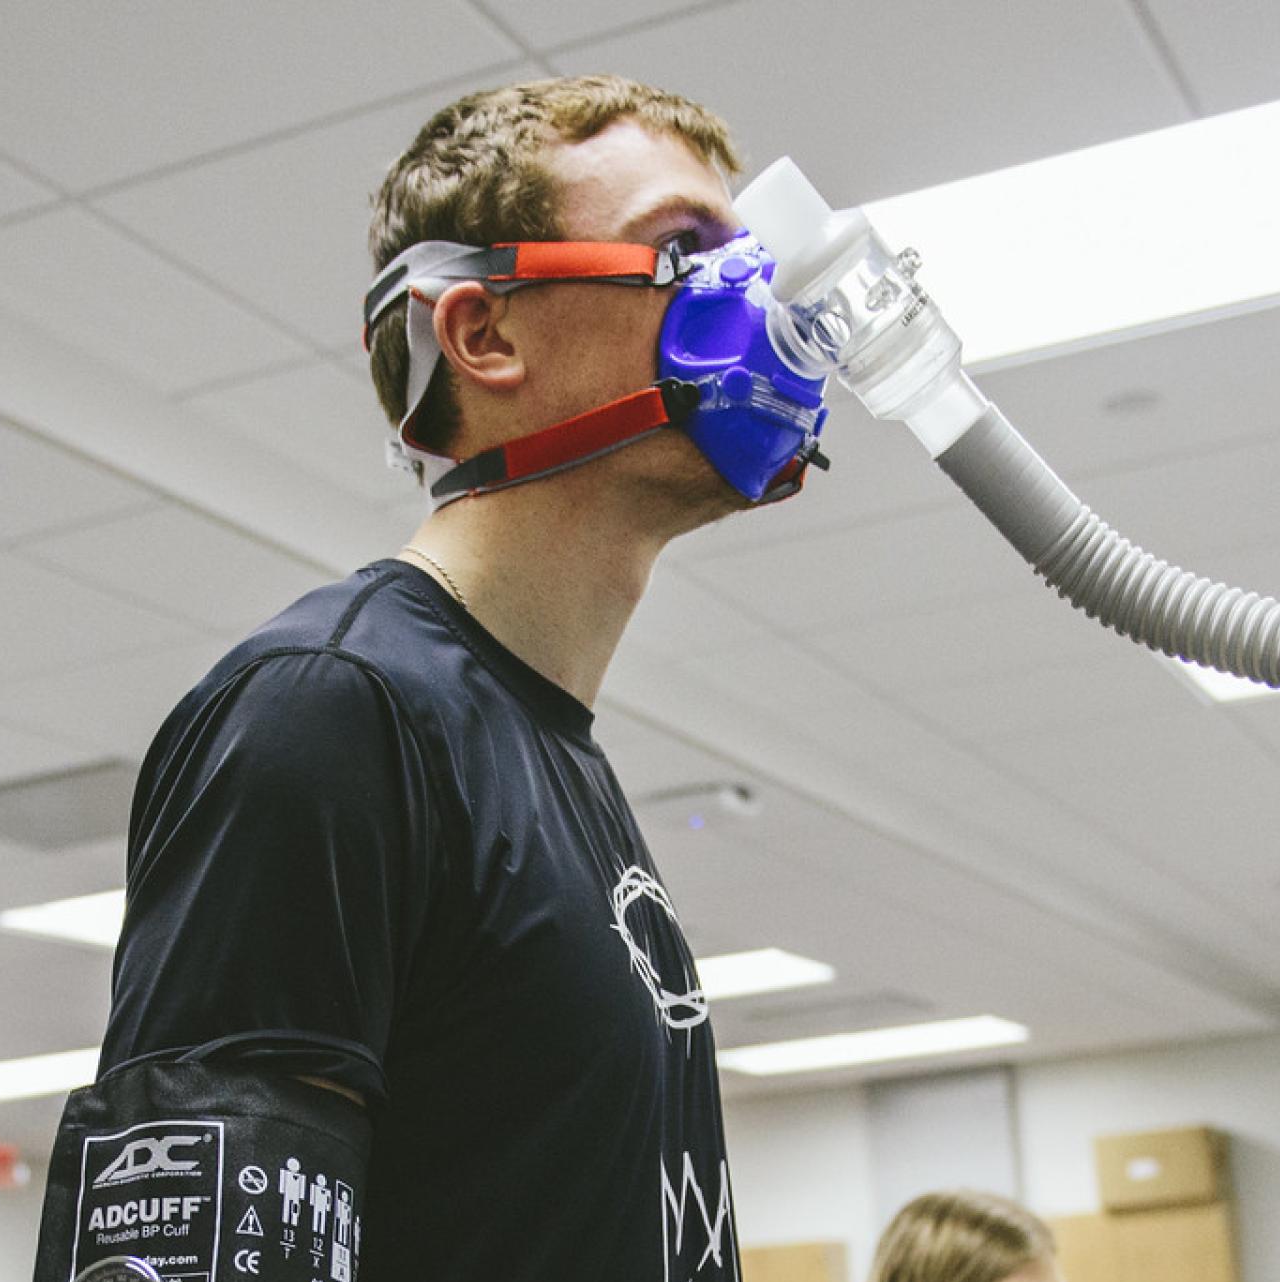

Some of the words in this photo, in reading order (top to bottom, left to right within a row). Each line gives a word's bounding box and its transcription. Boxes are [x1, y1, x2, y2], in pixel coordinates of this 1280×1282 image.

[93, 1136, 202, 1184] ADC
[142, 1225, 160, 1239] BP
[163, 1223, 190, 1237] Cuff
